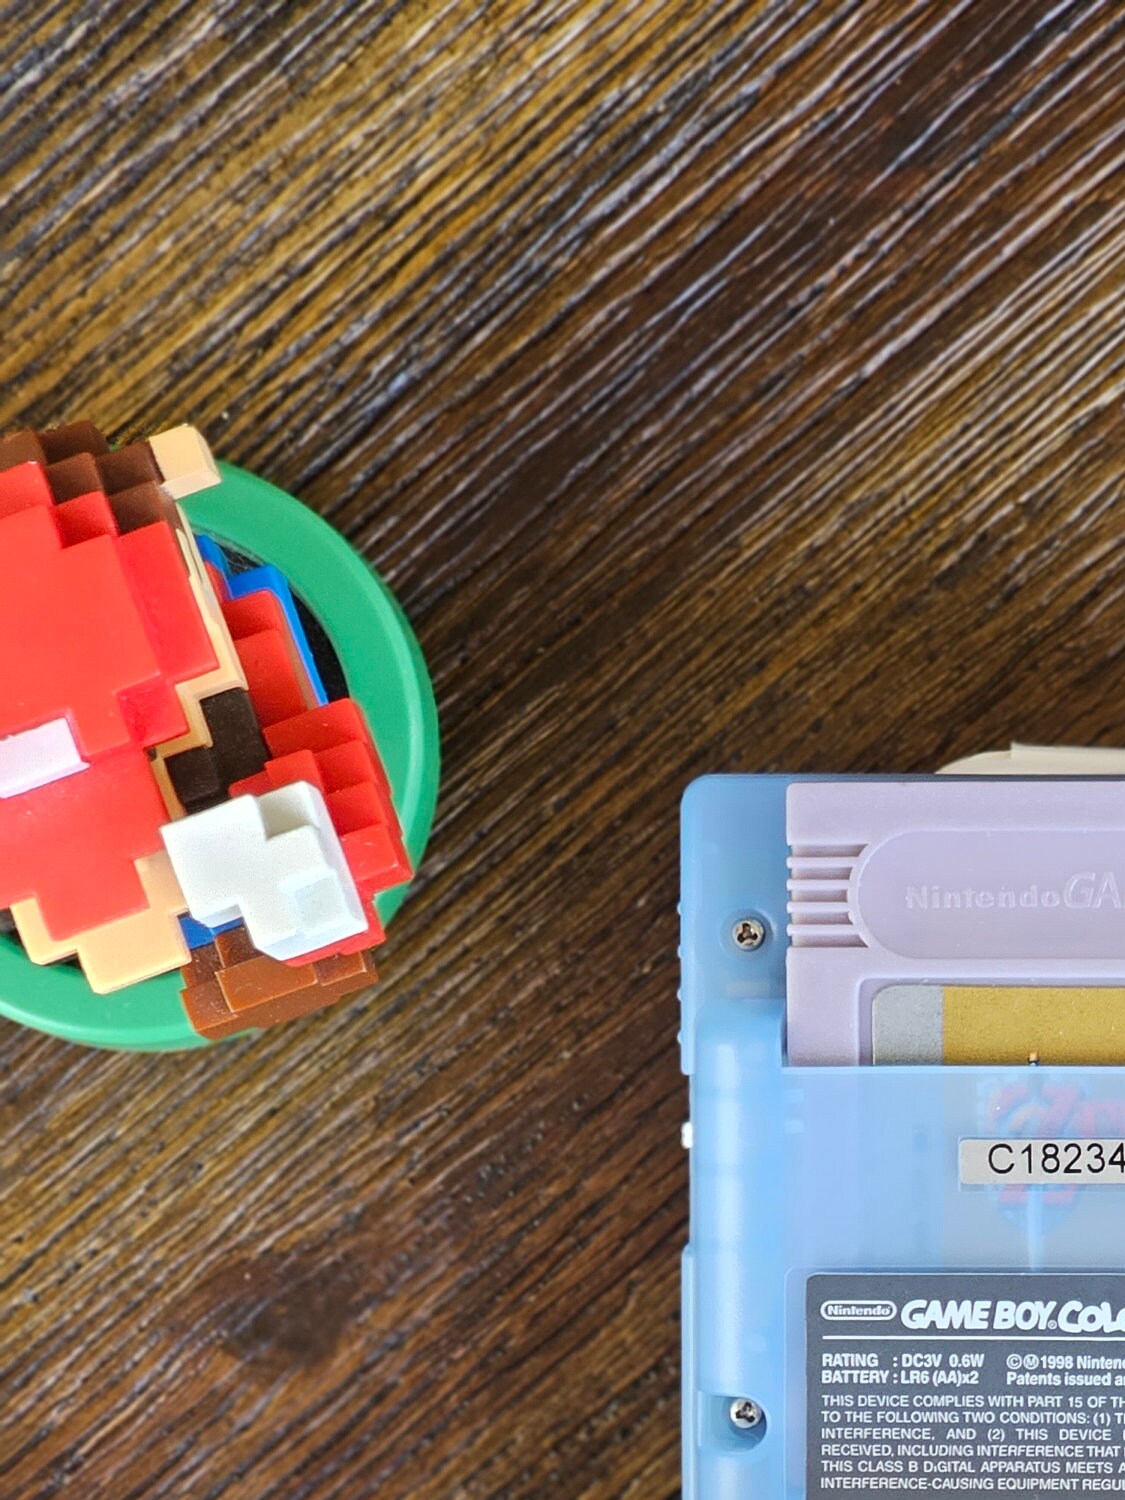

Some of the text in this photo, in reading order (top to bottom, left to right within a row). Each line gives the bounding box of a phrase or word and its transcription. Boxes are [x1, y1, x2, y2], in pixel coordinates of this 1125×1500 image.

[906, 885, 1060, 911] Nintendo
[826, 1304, 890, 1318] Nintendo
[822, 1352, 878, 1367] RATING
[901, 1352, 942, 1367] DC3V
[949, 1353, 984, 1367] 0.6W
[821, 1369, 889, 1384] BATTERY
[900, 1369, 929, 1384] LR6
[932, 1369, 978, 1387] (AA)x2
[1006, 1370, 1061, 1386] Patents
[1064, 1371, 1111, 1386] issued
[821, 1394, 854, 1407] THIS
[857, 1394, 909, 1407] DEVICE
[912, 1394, 984, 1407] COMPLIES
[987, 1394, 1024, 1407] WITH
[1027, 1395, 1063, 1407] PART
[1068, 1396, 1083, 1408] 15
[1087, 1395, 1107, 1408] OF
[820, 1410, 841, 1423] TO
[844, 1410, 872, 1423] THE
[876, 1410, 959, 1423] FOLLOWING
[962, 1411, 995, 1423] TWO
[999, 1411, 1089, 1424] CONDITIONS:
[1093, 1412, 1110, 1426] (1)
[946, 1427, 976, 1440] AND
[987, 1428, 1005, 1442] (2)
[1015, 1428, 1048, 1440] THIS
[1059, 1428, 1111, 1441] DEVICE
[897, 1444, 973, 1457] INCLUDING
[977, 1444, 1084, 1457] INTERFERENCE
[1086, 1445, 1121, 1457] THAT
[820, 1460, 853, 1472] THIS
[857, 1460, 903, 1472] CLASS
[908, 1460, 918, 1472] B
[980, 1460, 1060, 1473] APPARATUS
[1065, 1461, 1113, 1474] MEETS
[820, 1476, 994, 1490] INTERFERENCE-CAUSING
[997, 1477, 1079, 1490] EQUIPMENT
